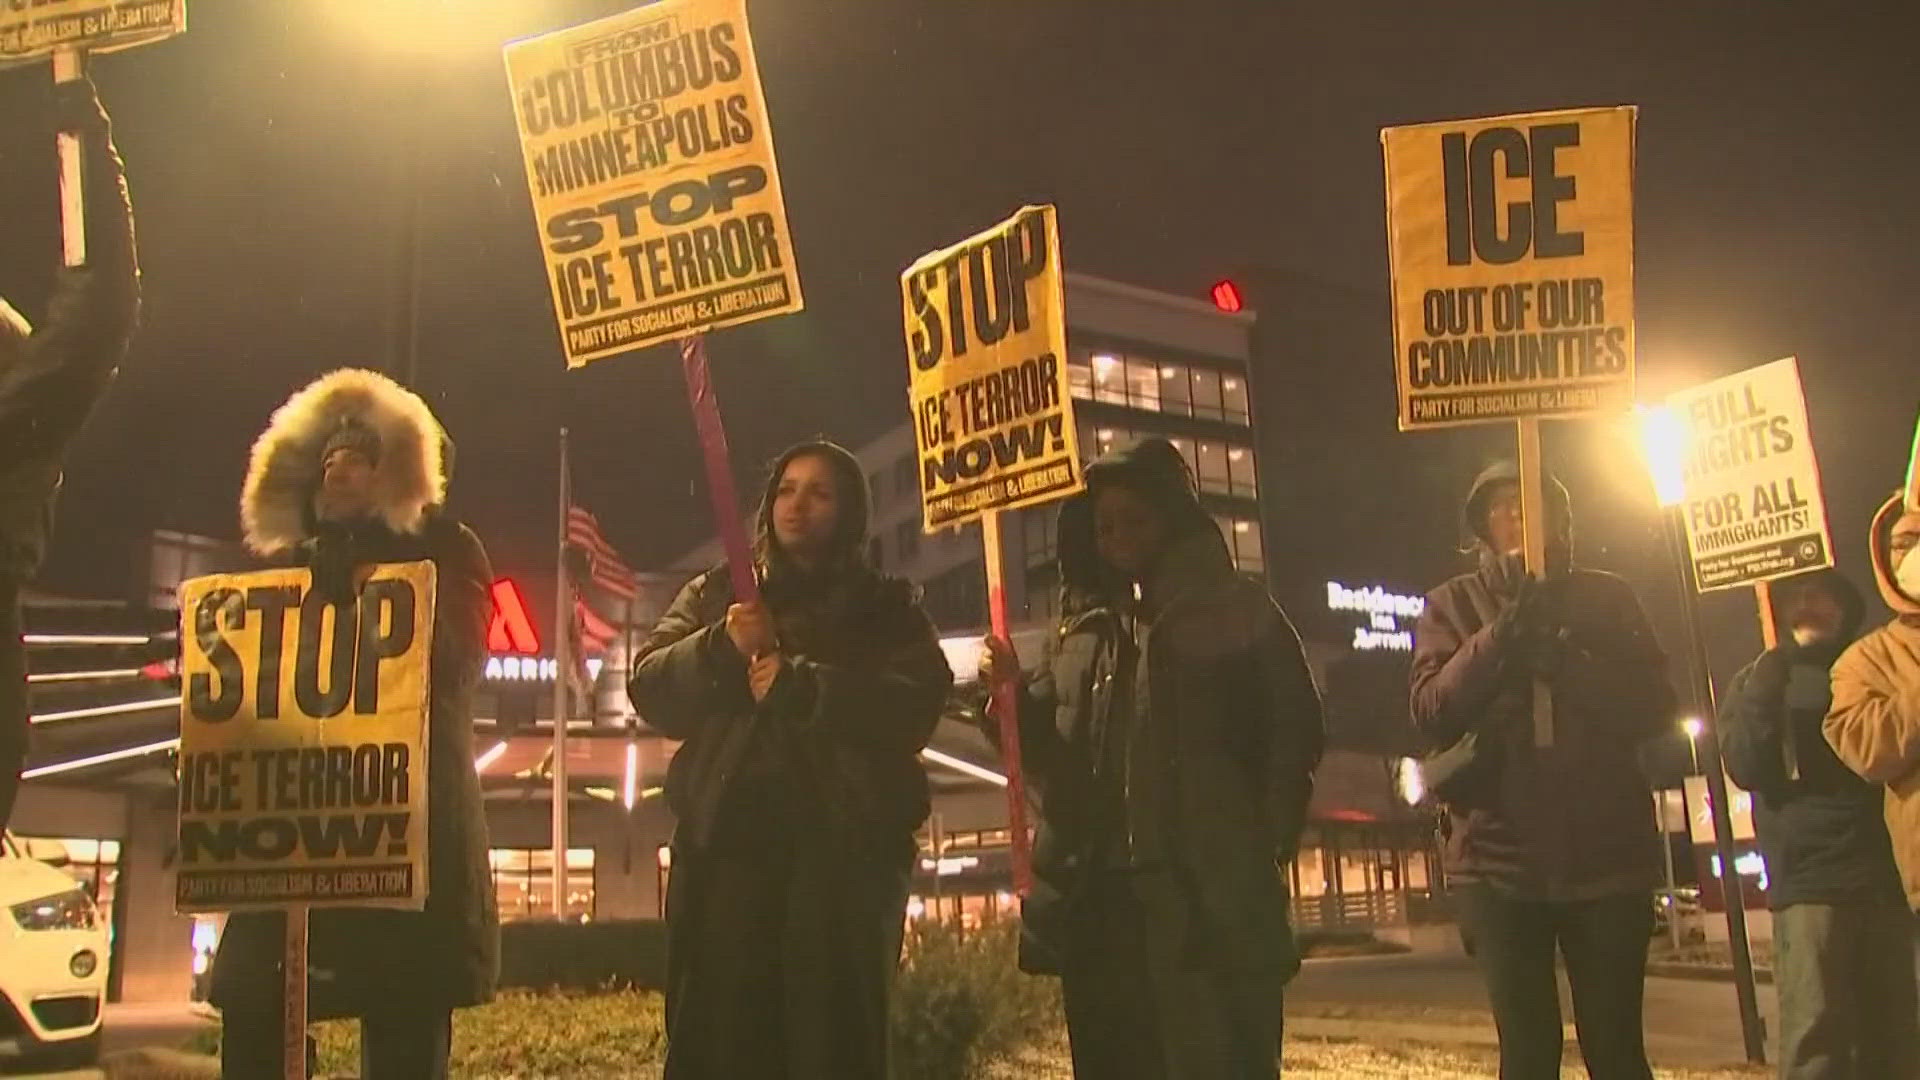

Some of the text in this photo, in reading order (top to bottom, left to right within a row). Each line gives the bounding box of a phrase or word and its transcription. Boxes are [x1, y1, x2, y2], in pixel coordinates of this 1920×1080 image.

[575, 21, 671, 63] FROM
[522, 23, 742, 136] COLUMBUS
[534, 96, 753, 196] MINNEAPOLIS
[612, 102, 661, 126] TO
[546, 165, 768, 254] STOP
[1441, 122, 1584, 266] ICE
[556, 212, 783, 319] ICE TERROR
[909, 211, 1048, 372] STOP
[570, 282, 785, 350] PARTY FOR SOCIALISM & LIBERATION
[1424, 276, 1604, 336] OUT OF OUR
[1408, 326, 1627, 389] COMMUNITIES
[919, 351, 1059, 451] ICE TERROR
[1413, 399, 1450, 418] PARTY
[1452, 397, 1475, 415] FOR
[1476, 392, 1537, 414] SOCIALISM
[925, 413, 1065, 491] NOW!
[1684, 415, 1793, 482] IGHTS
[1007, 478, 1019, 497] &
[1689, 477, 1808, 531] FOR ALL
[1696, 510, 1809, 552] IMMIGRANTS!
[190, 578, 415, 723] STOP
[182, 743, 409, 811] ICE TERROR
[181, 812, 410, 862] NOW!
[334, 867, 408, 896] LIBERATION
